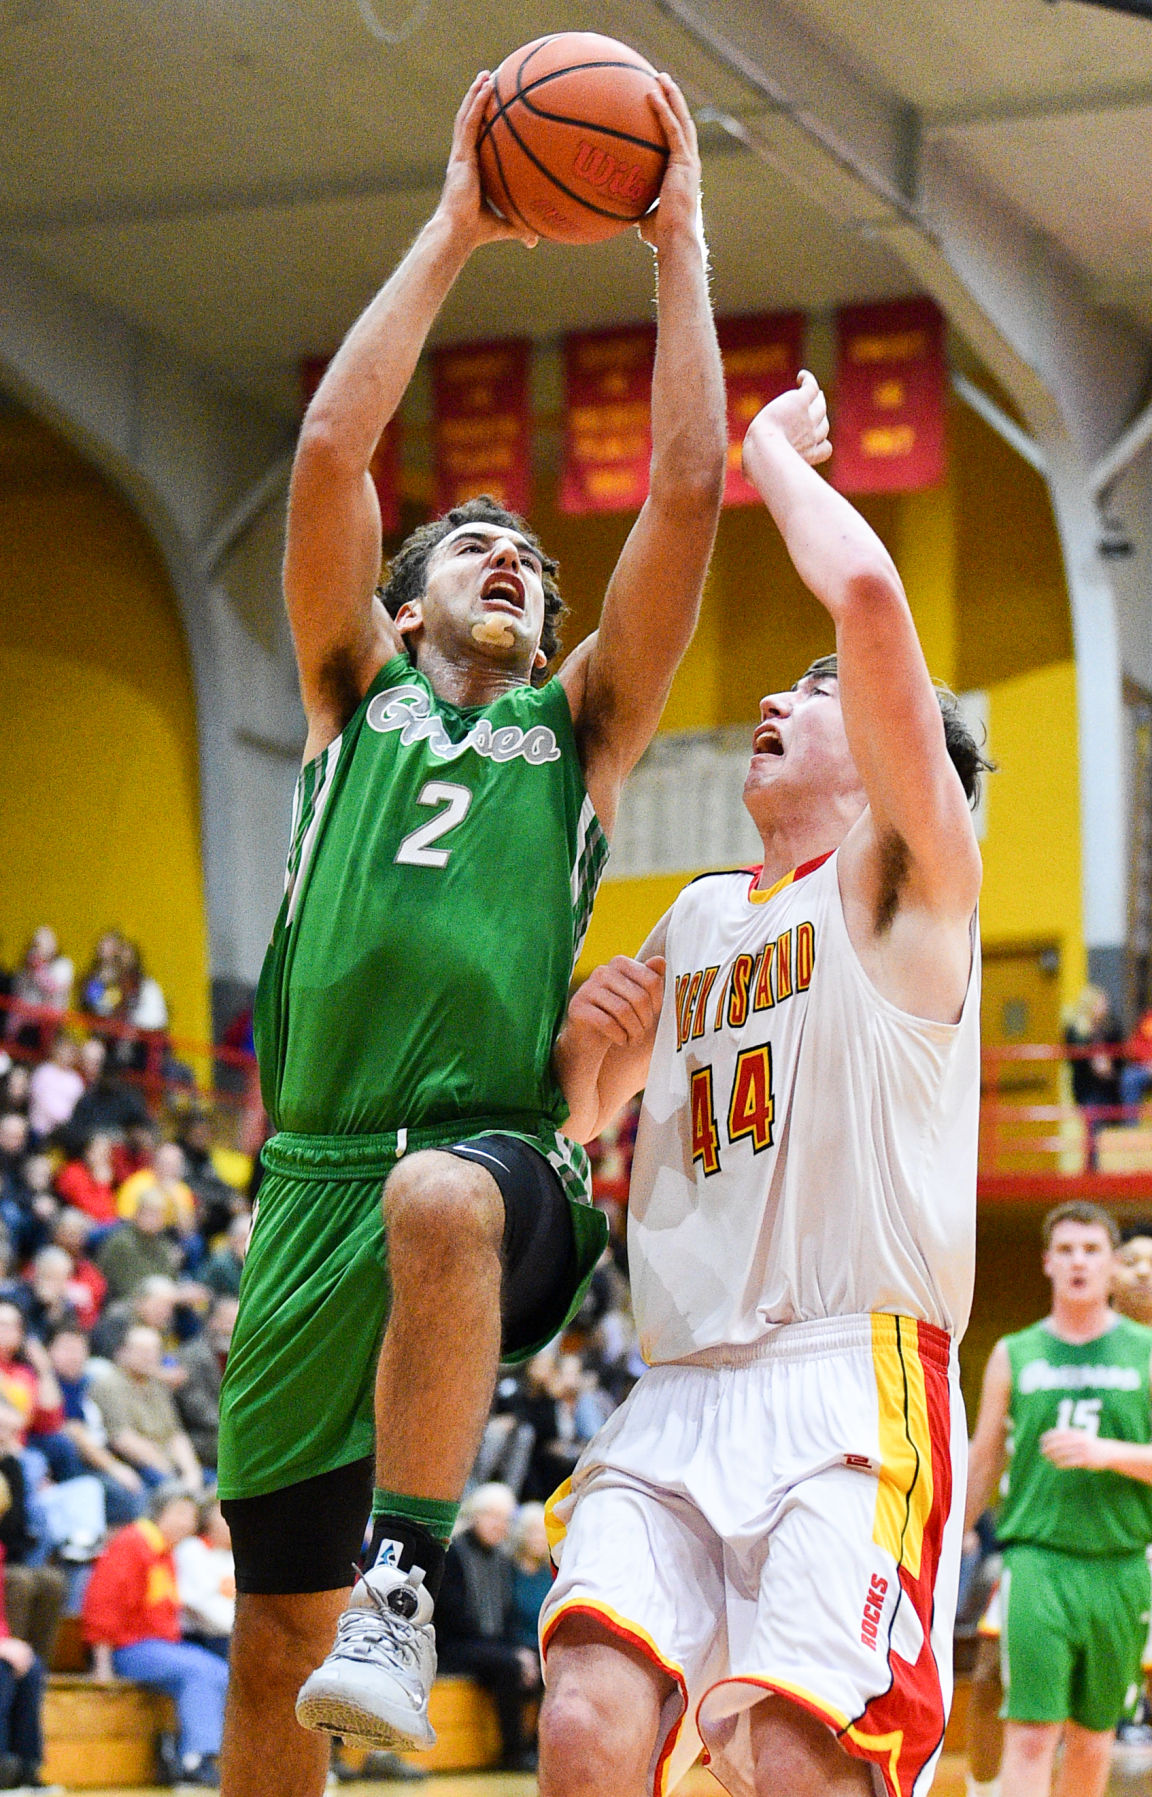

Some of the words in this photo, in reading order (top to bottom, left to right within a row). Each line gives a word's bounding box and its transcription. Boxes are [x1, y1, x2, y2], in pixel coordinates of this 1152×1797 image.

[394, 780, 473, 869] 2
[691, 1041, 775, 1178] 44
[1056, 1398, 1103, 1438] 15
[861, 1573, 888, 1651] ROCKS
